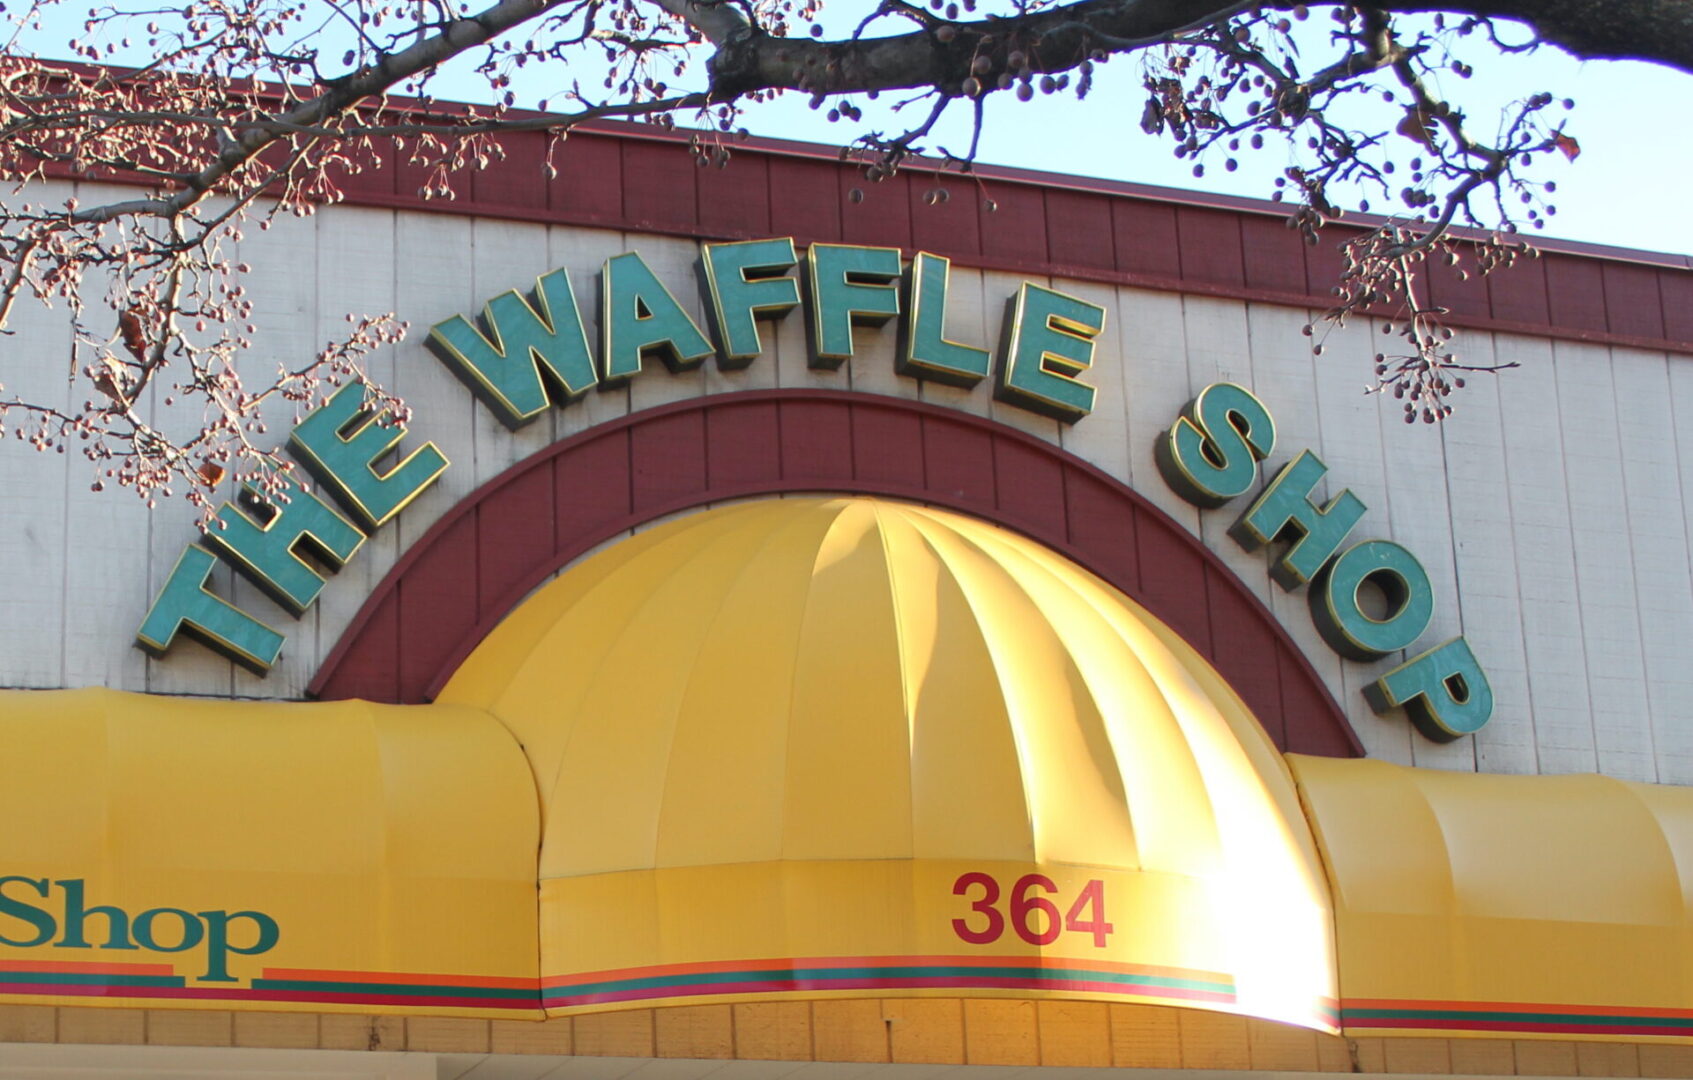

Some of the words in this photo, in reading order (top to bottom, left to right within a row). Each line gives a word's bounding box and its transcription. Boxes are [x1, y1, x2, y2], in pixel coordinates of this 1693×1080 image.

[136, 376, 450, 669] THE
[428, 237, 1106, 422] WAFFLE
[1158, 382, 1495, 738] SHOP
[0, 875, 280, 982] Shop
[951, 871, 1114, 948] 364
